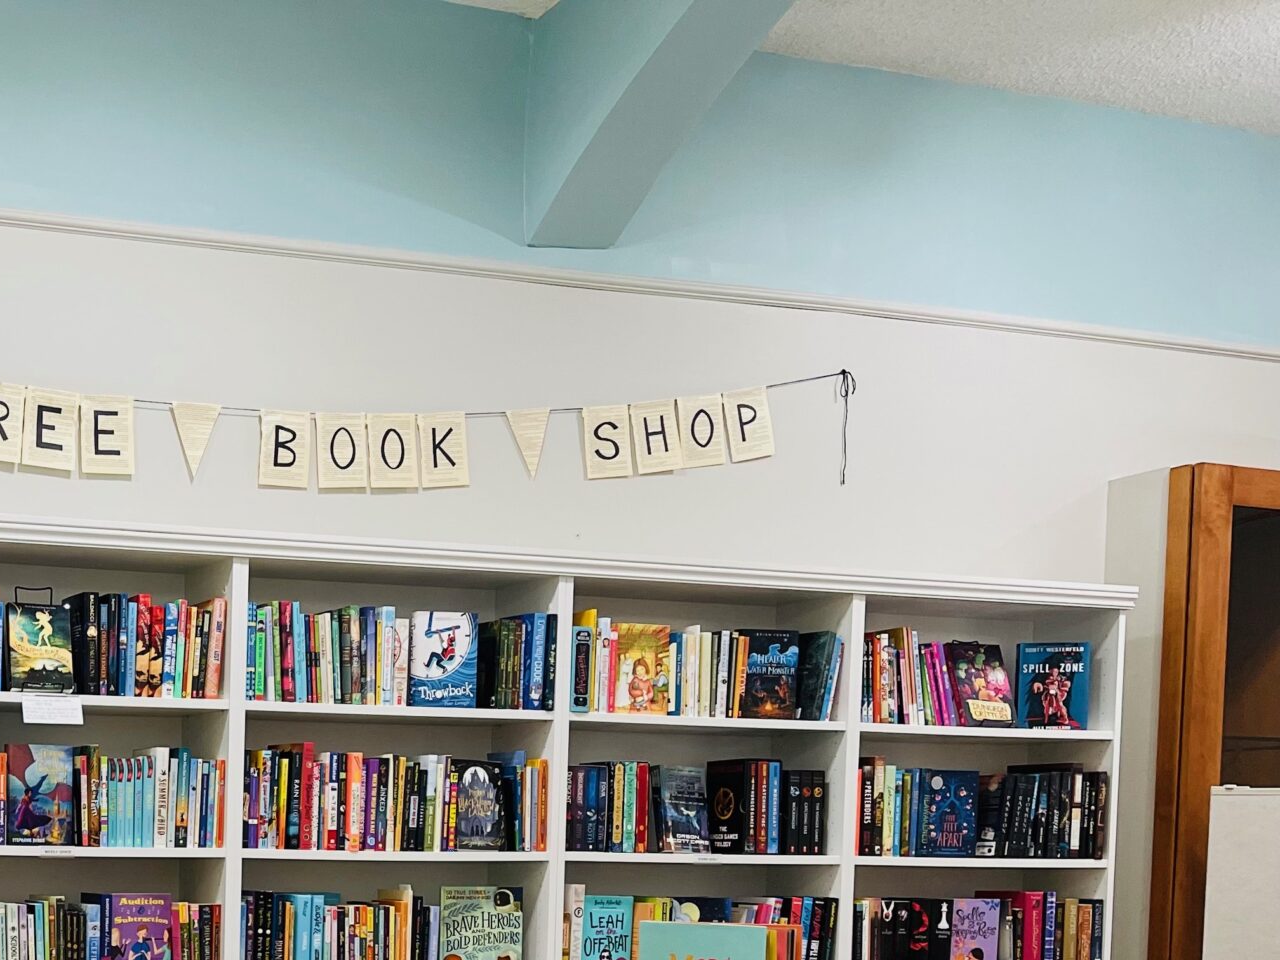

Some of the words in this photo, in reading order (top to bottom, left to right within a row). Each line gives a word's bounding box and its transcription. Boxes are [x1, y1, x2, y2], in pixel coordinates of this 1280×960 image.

[275, 425, 456, 471] BOOK
[593, 404, 757, 460] SHOP
[756, 653, 787, 664] HEALER
[533, 660, 542, 683] CODE
[768, 666, 795, 675] MONSTER
[1022, 663, 1050, 673] SPILL
[1059, 663, 1085, 673] ZONE
[418, 681, 474, 701] Throwback
[158, 779, 167, 810] SUMMER
[379, 786, 388, 812] JINXED
[158, 818, 166, 836] BIRD
[943, 822, 957, 831] FEET
[936, 832, 964, 847] APART
[119, 897, 164, 906] Audition
[114, 916, 169, 925] Subtraction
[444, 913, 480, 939] BRAVE
[481, 911, 521, 930] HEROES
[590, 911, 625, 930] LEAH
[956, 907, 986, 925] Spells
[446, 936, 470, 953] BOLD
[472, 931, 521, 946] DEFENDERS
